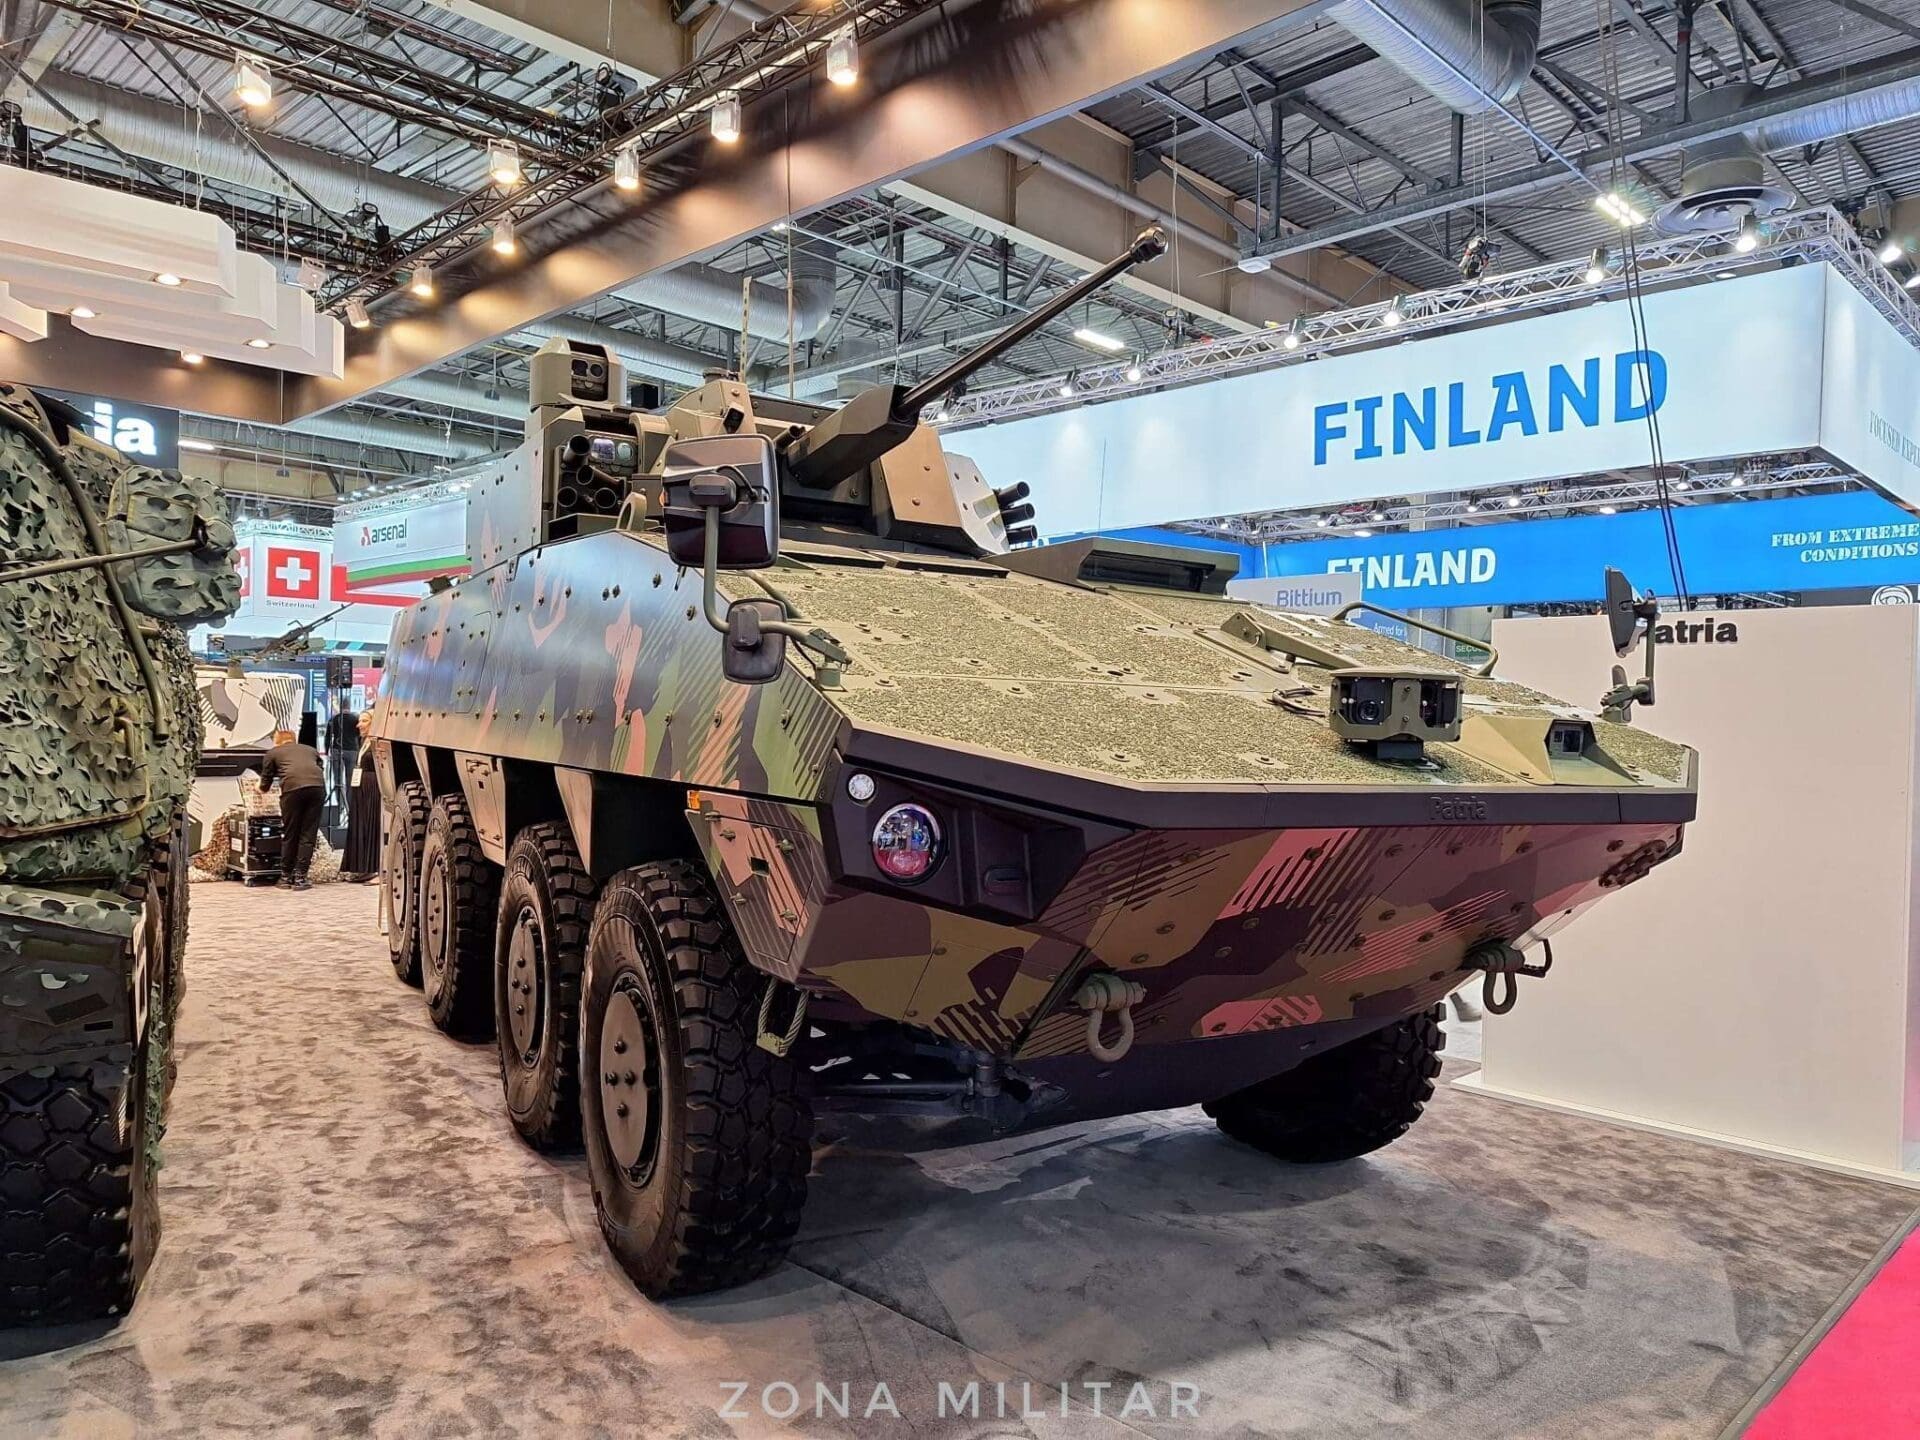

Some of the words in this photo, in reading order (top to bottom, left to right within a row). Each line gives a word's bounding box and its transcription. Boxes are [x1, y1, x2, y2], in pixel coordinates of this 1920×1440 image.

[1314, 350, 1668, 466] FINLAND
[84, 401, 158, 456] ia
[371, 518, 408, 544] arsenal
[1771, 530, 1822, 547] FROM
[1829, 523, 1920, 543] EXTREME
[1800, 542, 1919, 563] CONDITIONS
[266, 600, 315, 609] Switzerland
[1276, 588, 1342, 608] Bittium
[1637, 617, 1738, 644] atria
[1429, 795, 1488, 820] Patria
